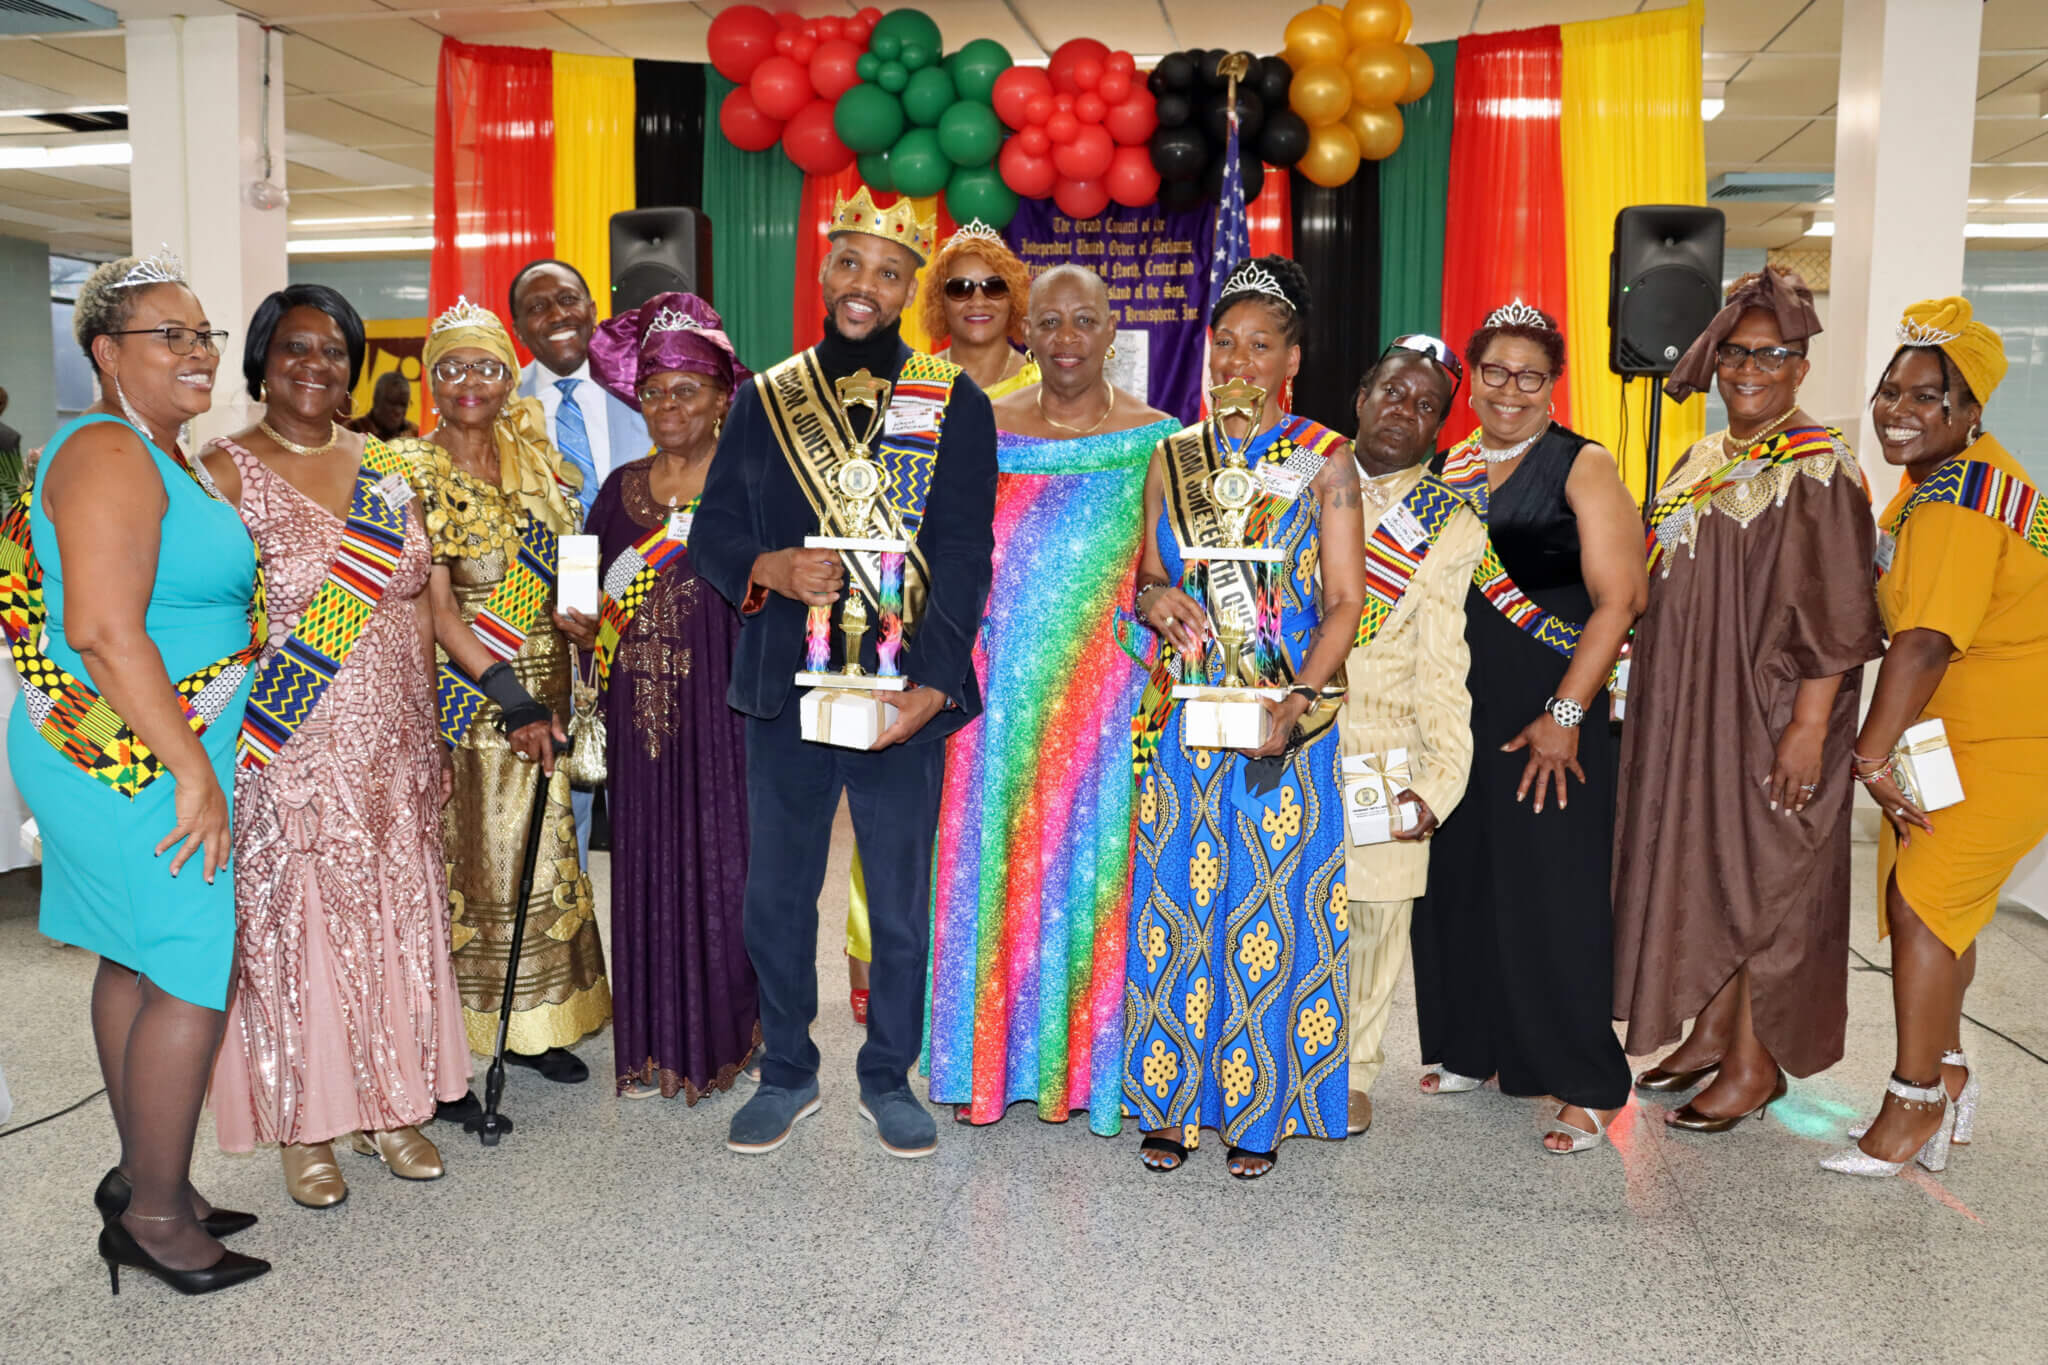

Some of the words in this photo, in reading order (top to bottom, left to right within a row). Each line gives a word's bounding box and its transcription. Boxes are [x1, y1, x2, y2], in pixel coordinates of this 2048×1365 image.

[1053, 216, 1071, 234] The
[1075, 218, 1102, 233] Grand
[1105, 216, 1138, 235] Council
[1142, 217, 1150, 233] of
[1153, 217, 1165, 232] the
[1021, 238, 1073, 257] Independent
[1076, 238, 1105, 256] United
[1108, 240, 1136, 257] Order
[1139, 239, 1147, 255] of
[1099, 261, 1108, 277] of
[1145, 259, 1177, 277] Central
[1180, 259, 1195, 276] and
[1134, 282, 1144, 299] of
[1146, 283, 1160, 300] the
